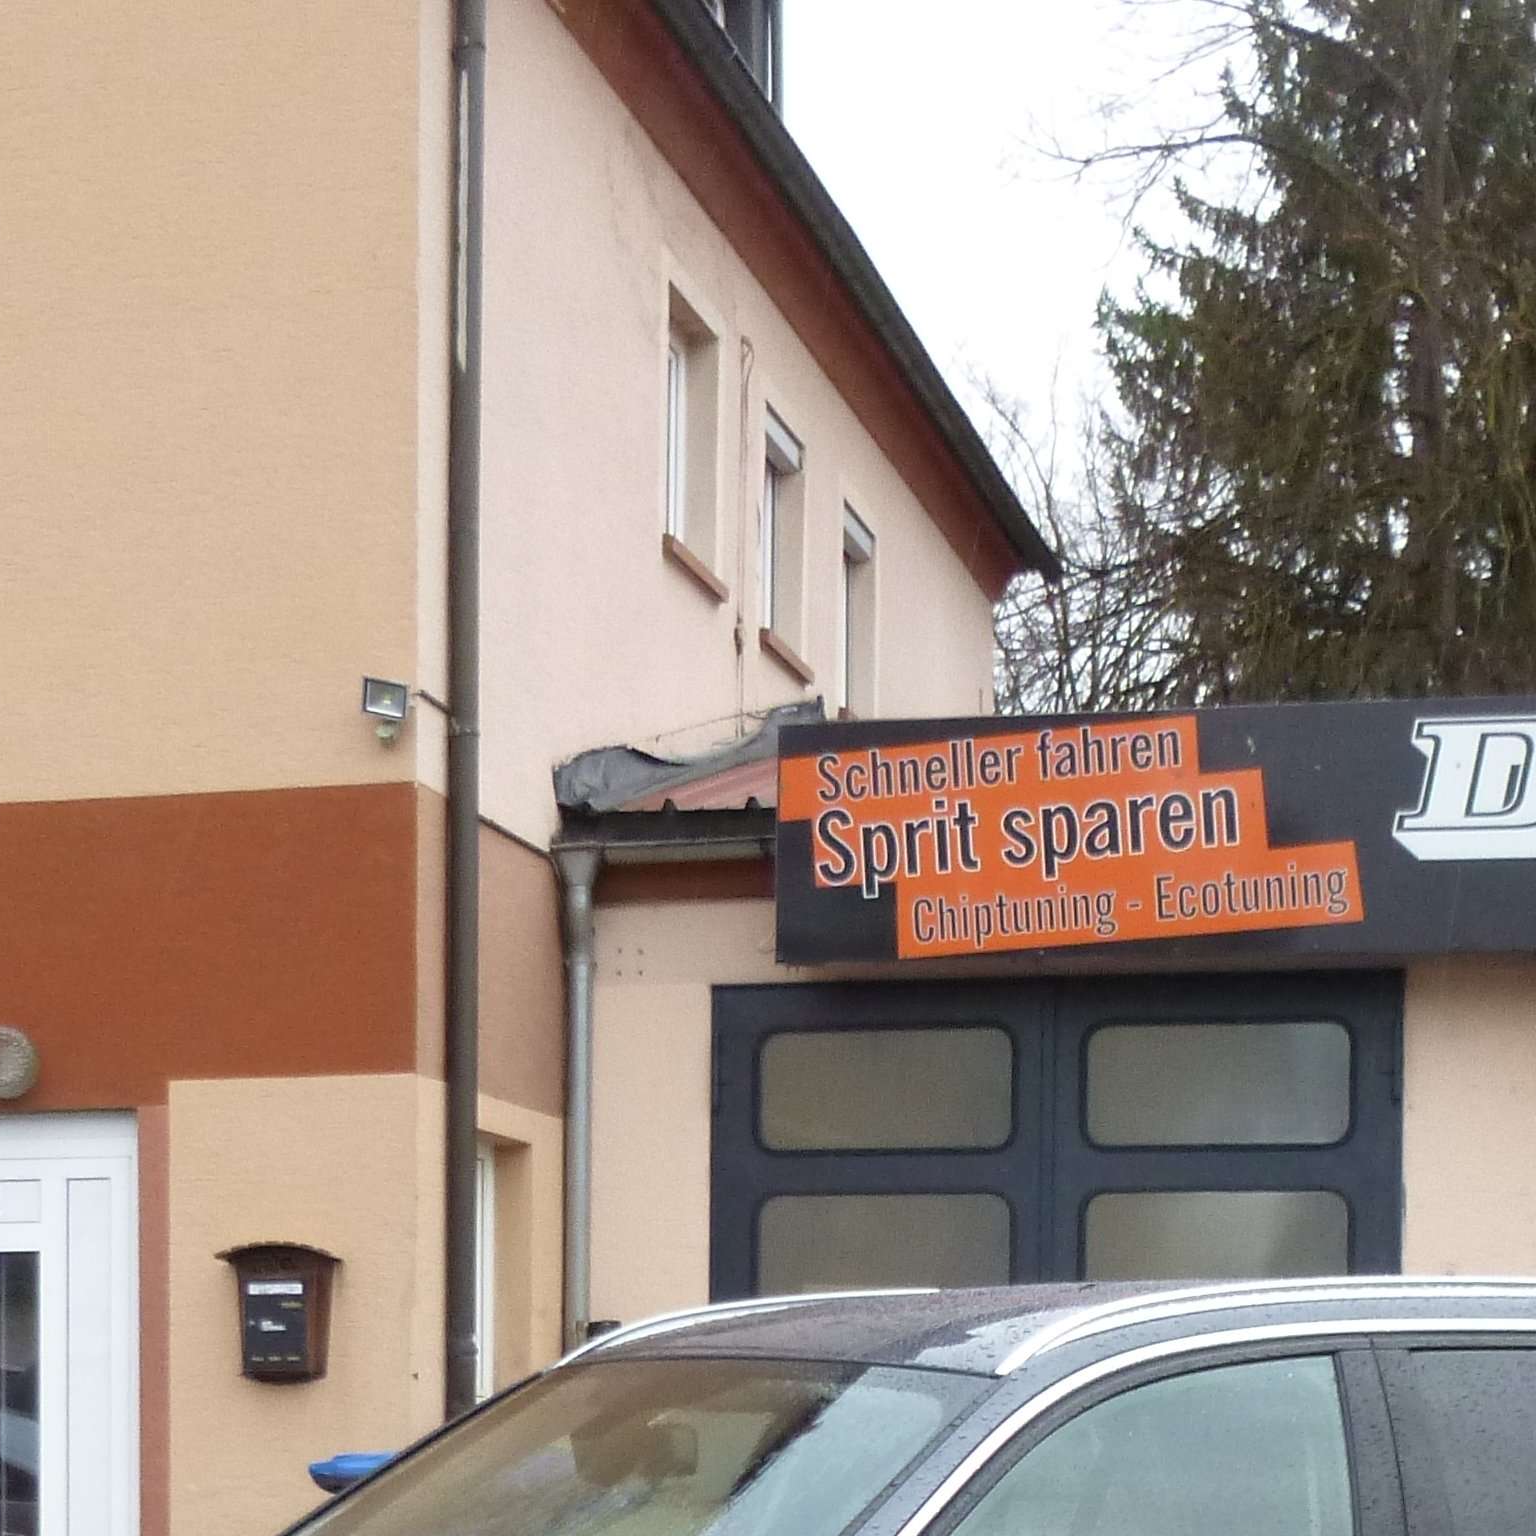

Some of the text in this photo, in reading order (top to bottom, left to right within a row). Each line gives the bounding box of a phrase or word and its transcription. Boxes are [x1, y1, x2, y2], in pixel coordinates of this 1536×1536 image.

[816, 726, 1184, 804] Schneller fahren
[814, 782, 1241, 899] Sprit sparen
[912, 887, 1117, 946] Chiptuning
[1153, 864, 1349, 921] Ecotuning
